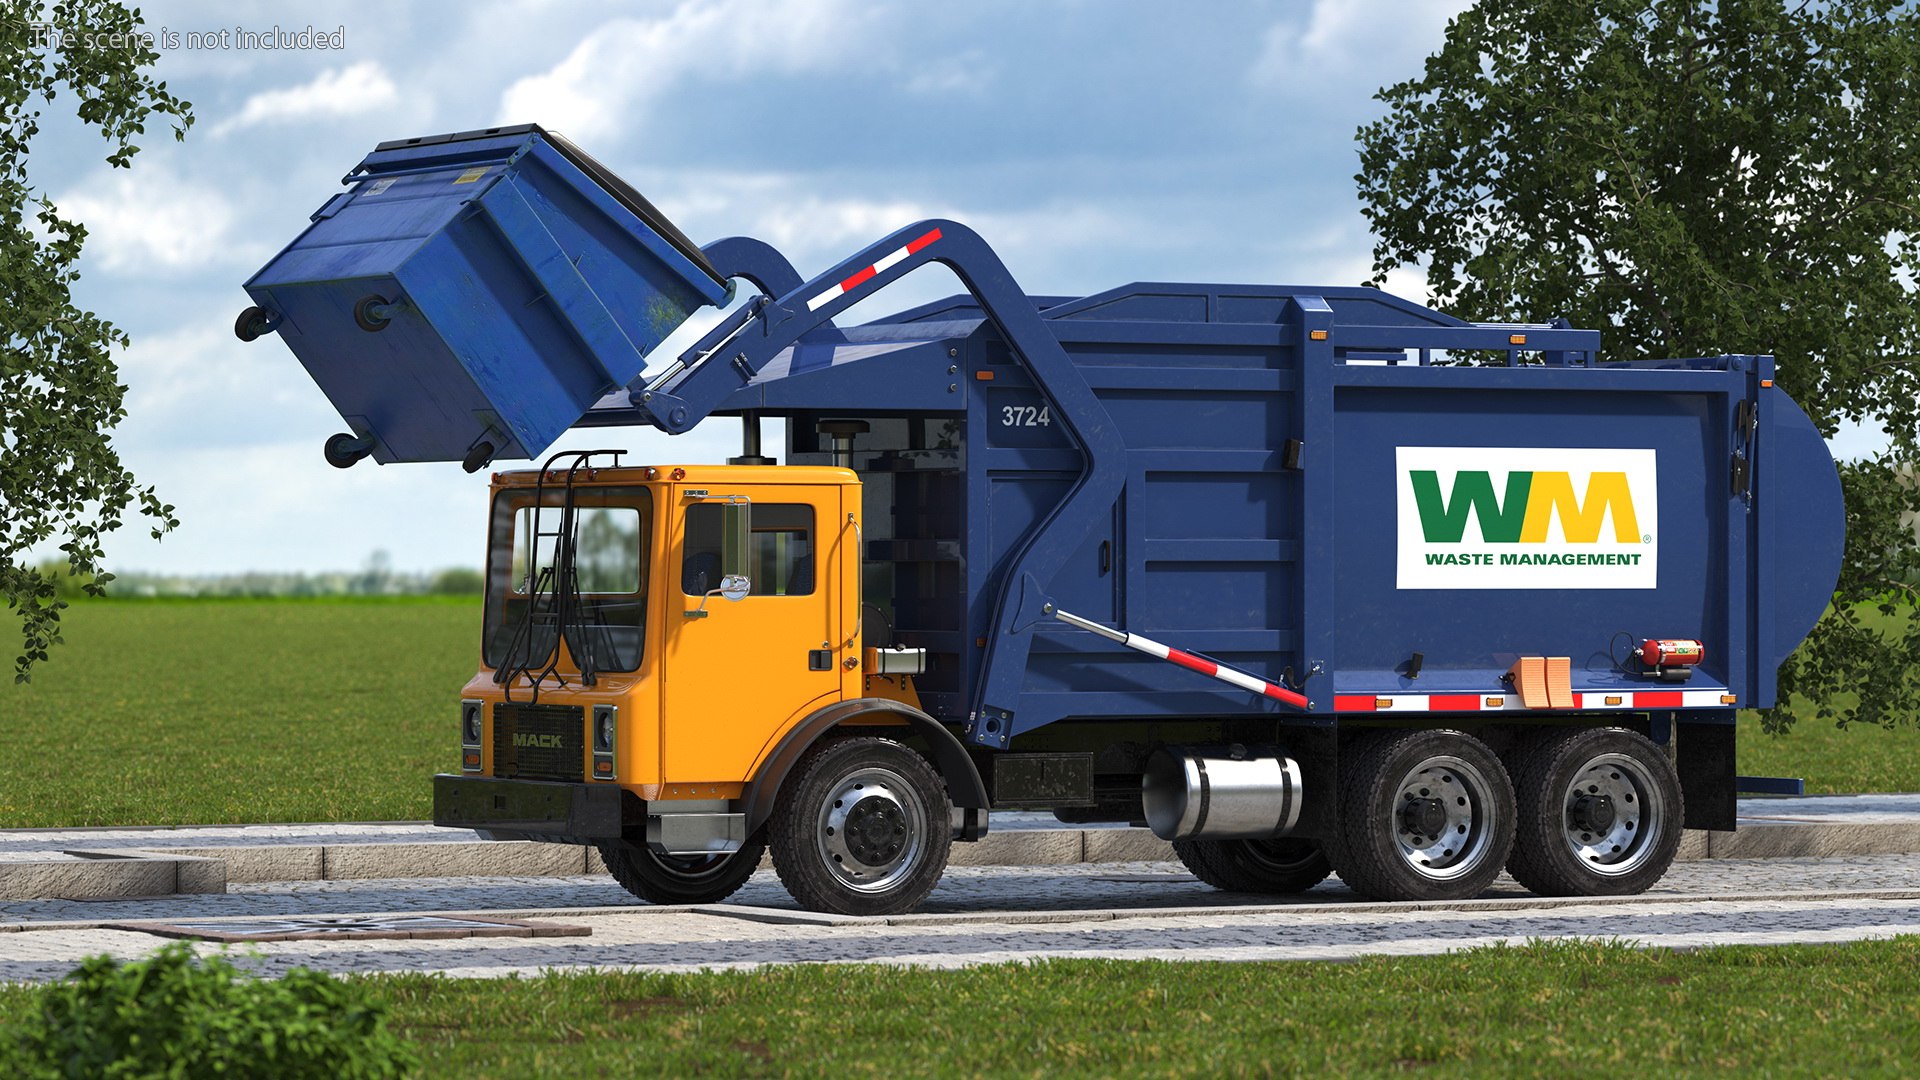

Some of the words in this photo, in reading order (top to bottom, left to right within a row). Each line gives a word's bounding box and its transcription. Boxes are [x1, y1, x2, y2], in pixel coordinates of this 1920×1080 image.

[1002, 405, 1050, 427] 3724
[1409, 470, 1642, 544] WM
[1425, 553, 1494, 566] WASTE
[1500, 553, 1642, 566] MANAGEMENT
[512, 732, 563, 749] MACK
